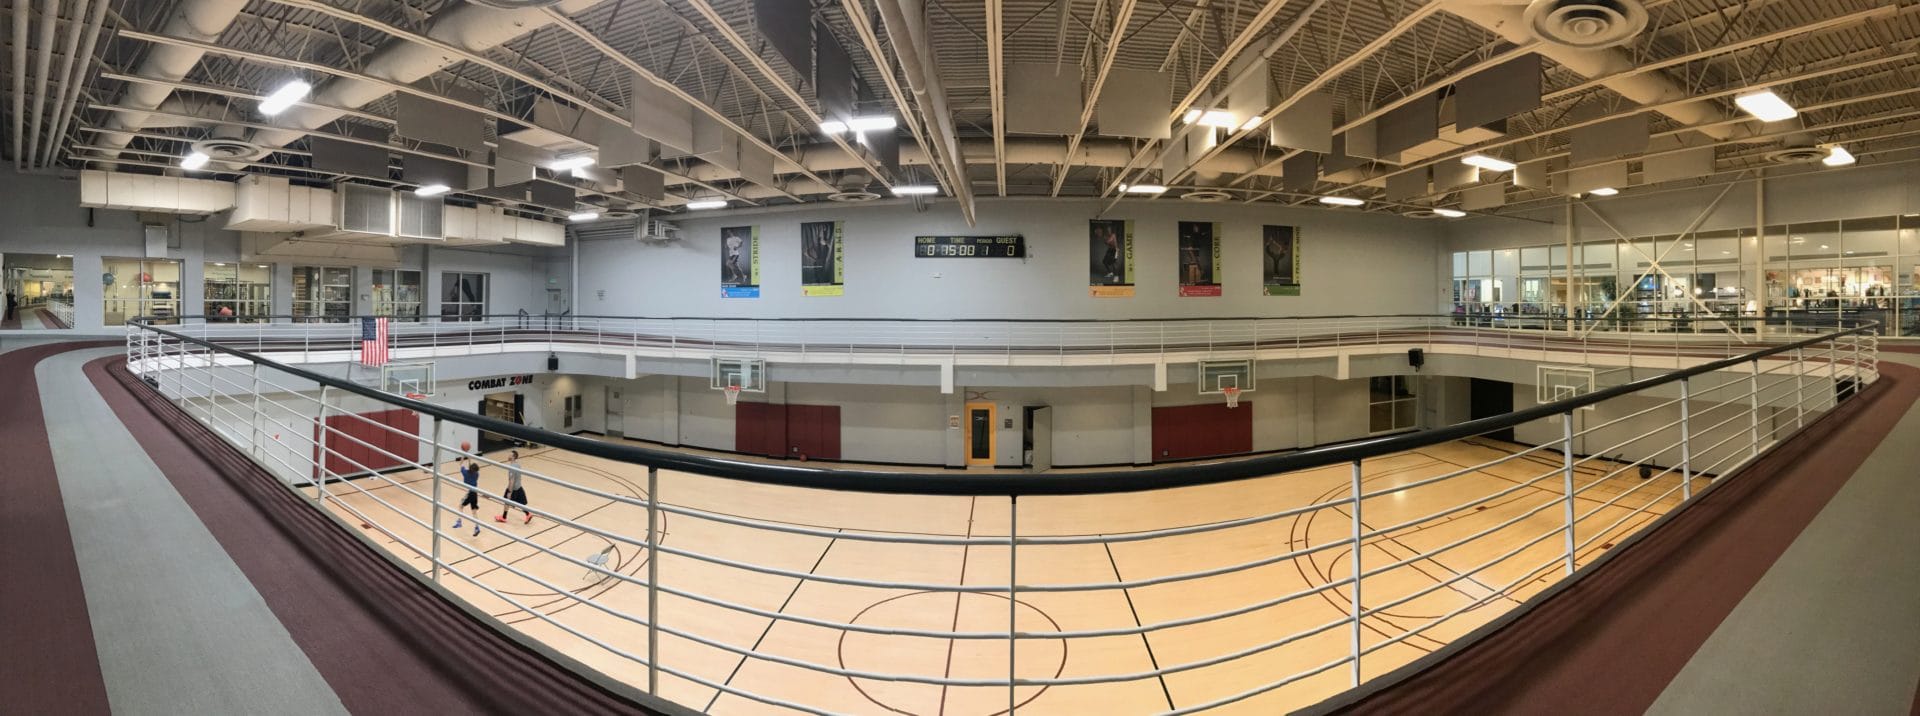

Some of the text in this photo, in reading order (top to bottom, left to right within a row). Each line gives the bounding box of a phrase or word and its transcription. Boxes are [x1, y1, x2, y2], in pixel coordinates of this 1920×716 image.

[1007, 245, 1015, 256] 0
[468, 374, 534, 390] COMBAT ZONE
